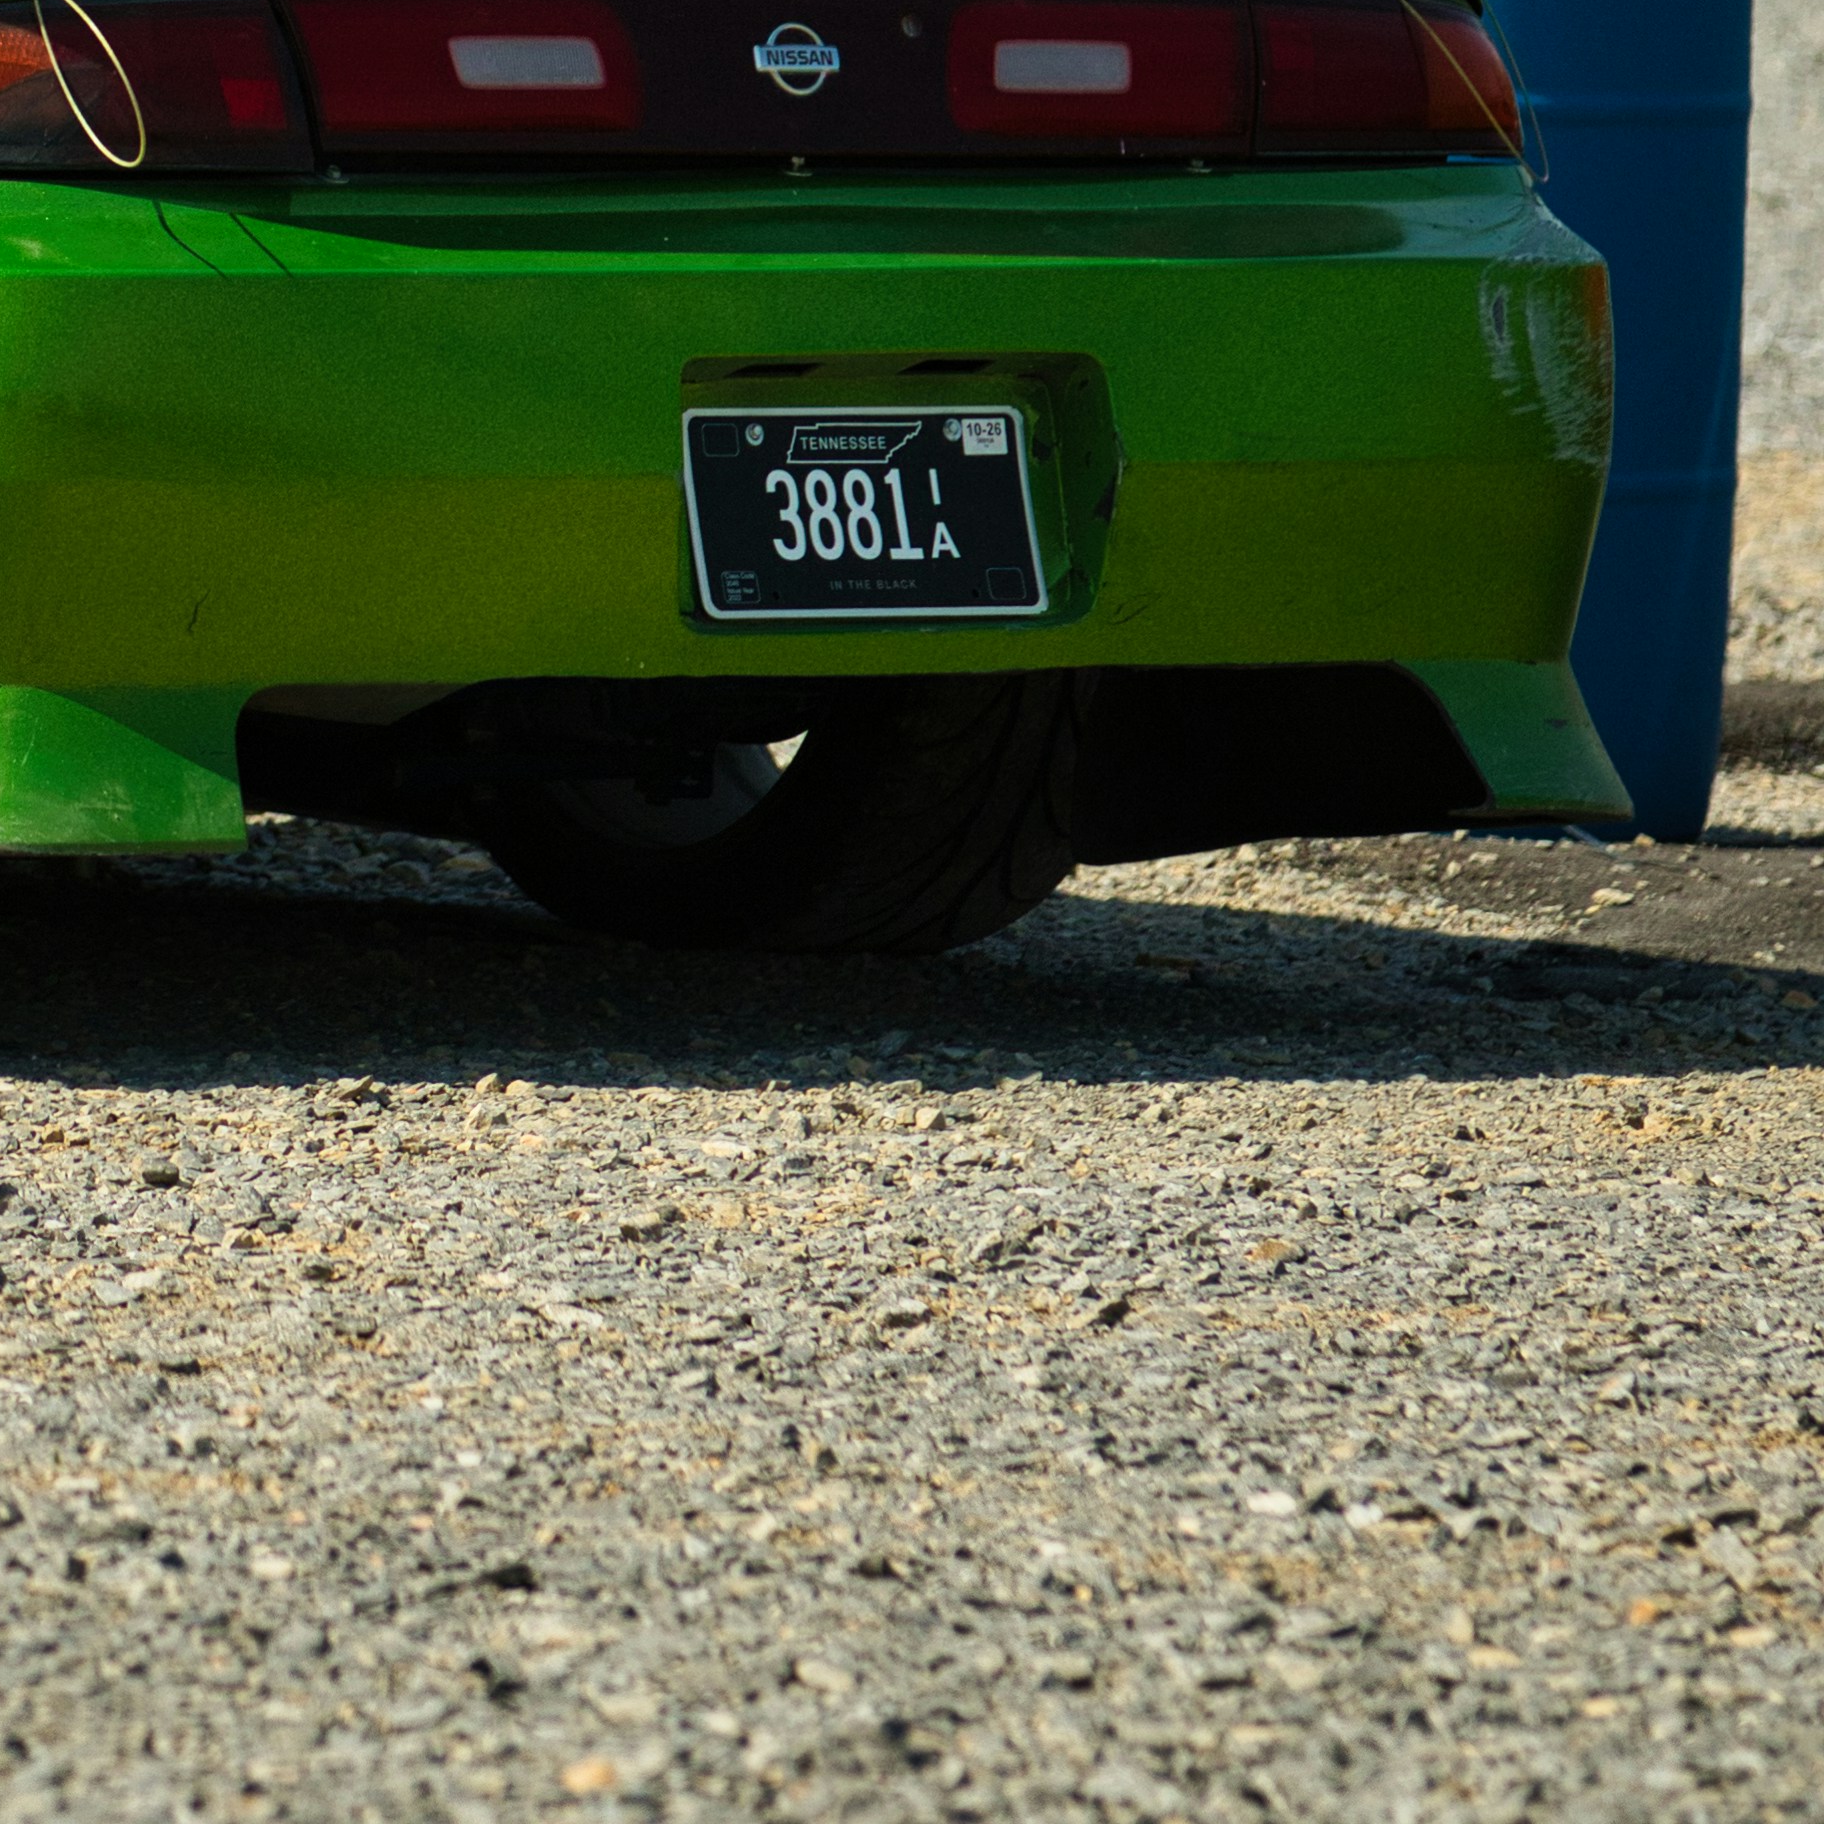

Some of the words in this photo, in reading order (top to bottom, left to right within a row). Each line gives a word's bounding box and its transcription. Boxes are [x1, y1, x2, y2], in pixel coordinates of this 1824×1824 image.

[765, 49, 834, 66] NISSAN
[966, 421, 1002, 437] 10-26
[799, 434, 887, 451] TENNESSEE
[765, 468, 925, 562] 3881
[829, 580, 843, 591] IN
[847, 579, 872, 590] THE
[876, 578, 918, 590] BLACK
